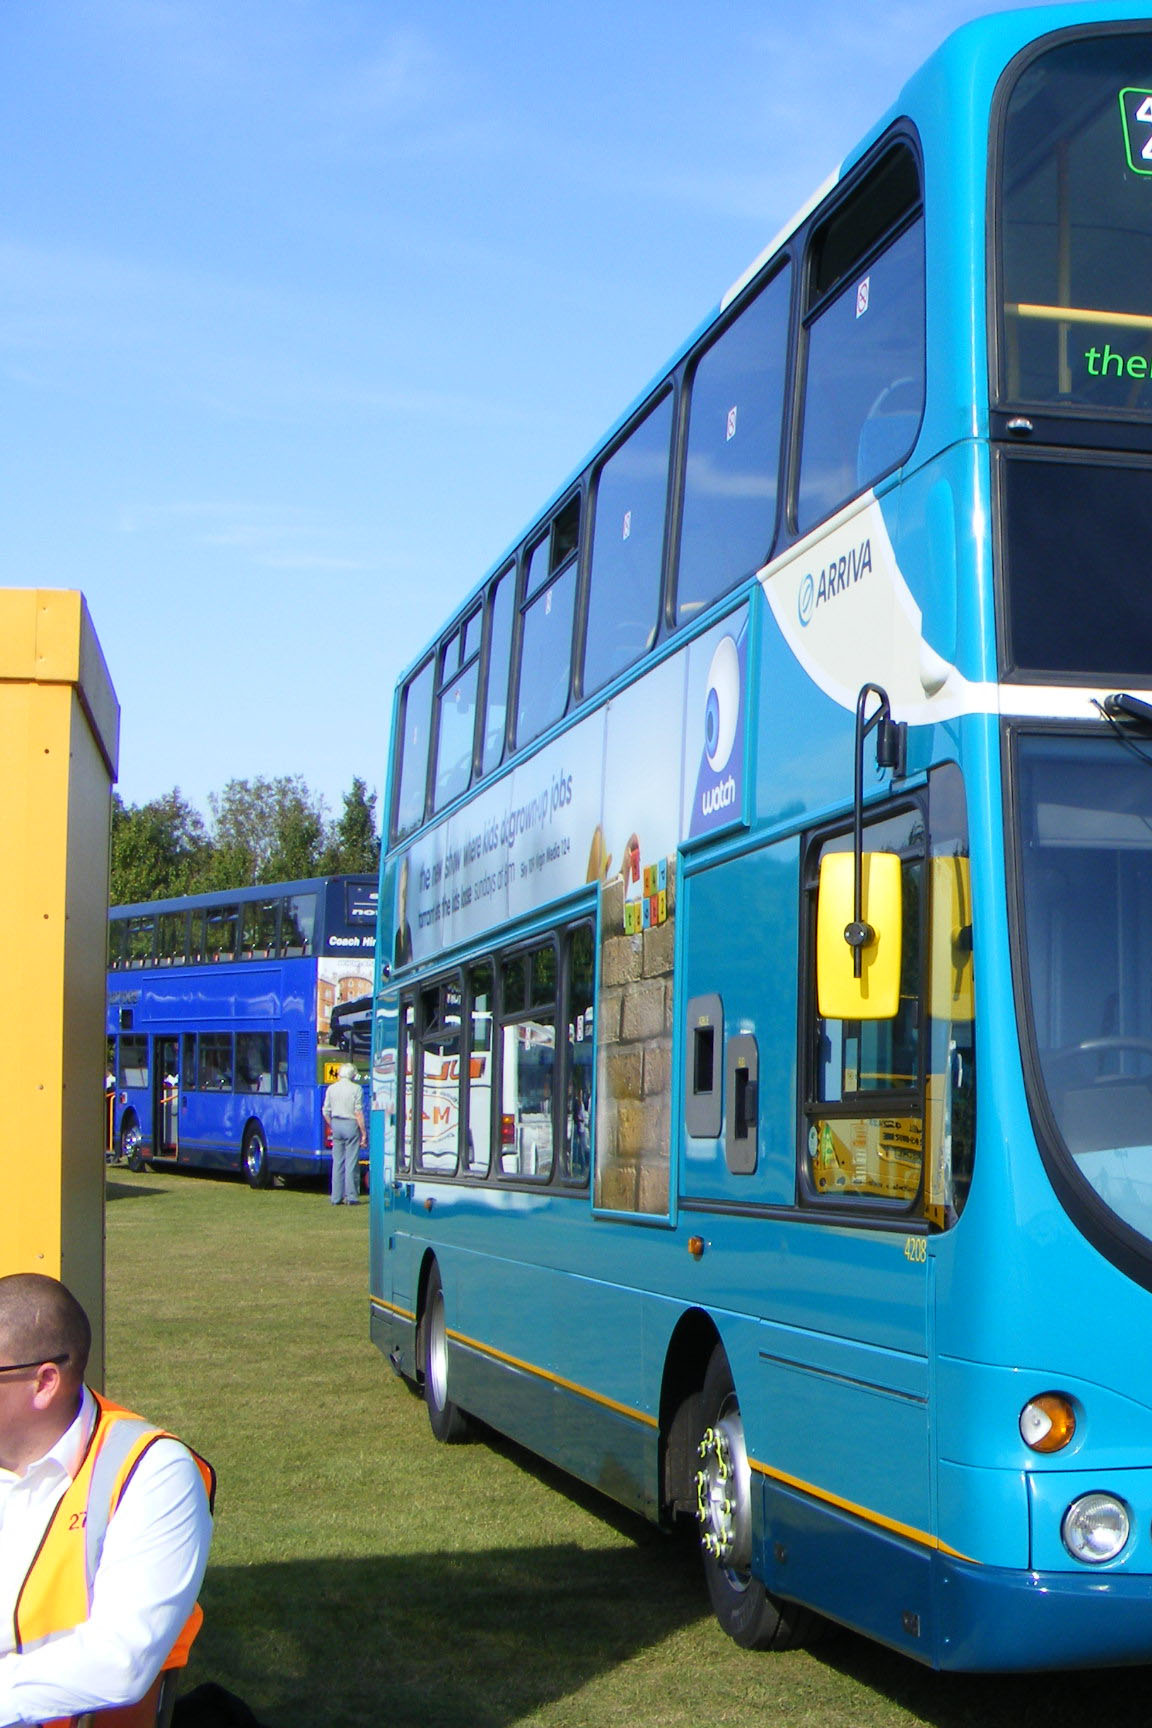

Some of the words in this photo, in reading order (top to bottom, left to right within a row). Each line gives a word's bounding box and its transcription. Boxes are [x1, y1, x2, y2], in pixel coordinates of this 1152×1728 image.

[816, 538, 872, 608] ARRIVA
[482, 816, 499, 854] kids
[550, 768, 573, 824] jobs
[329, 935, 360, 947] Coach
[904, 1237, 927, 1263] 4208
